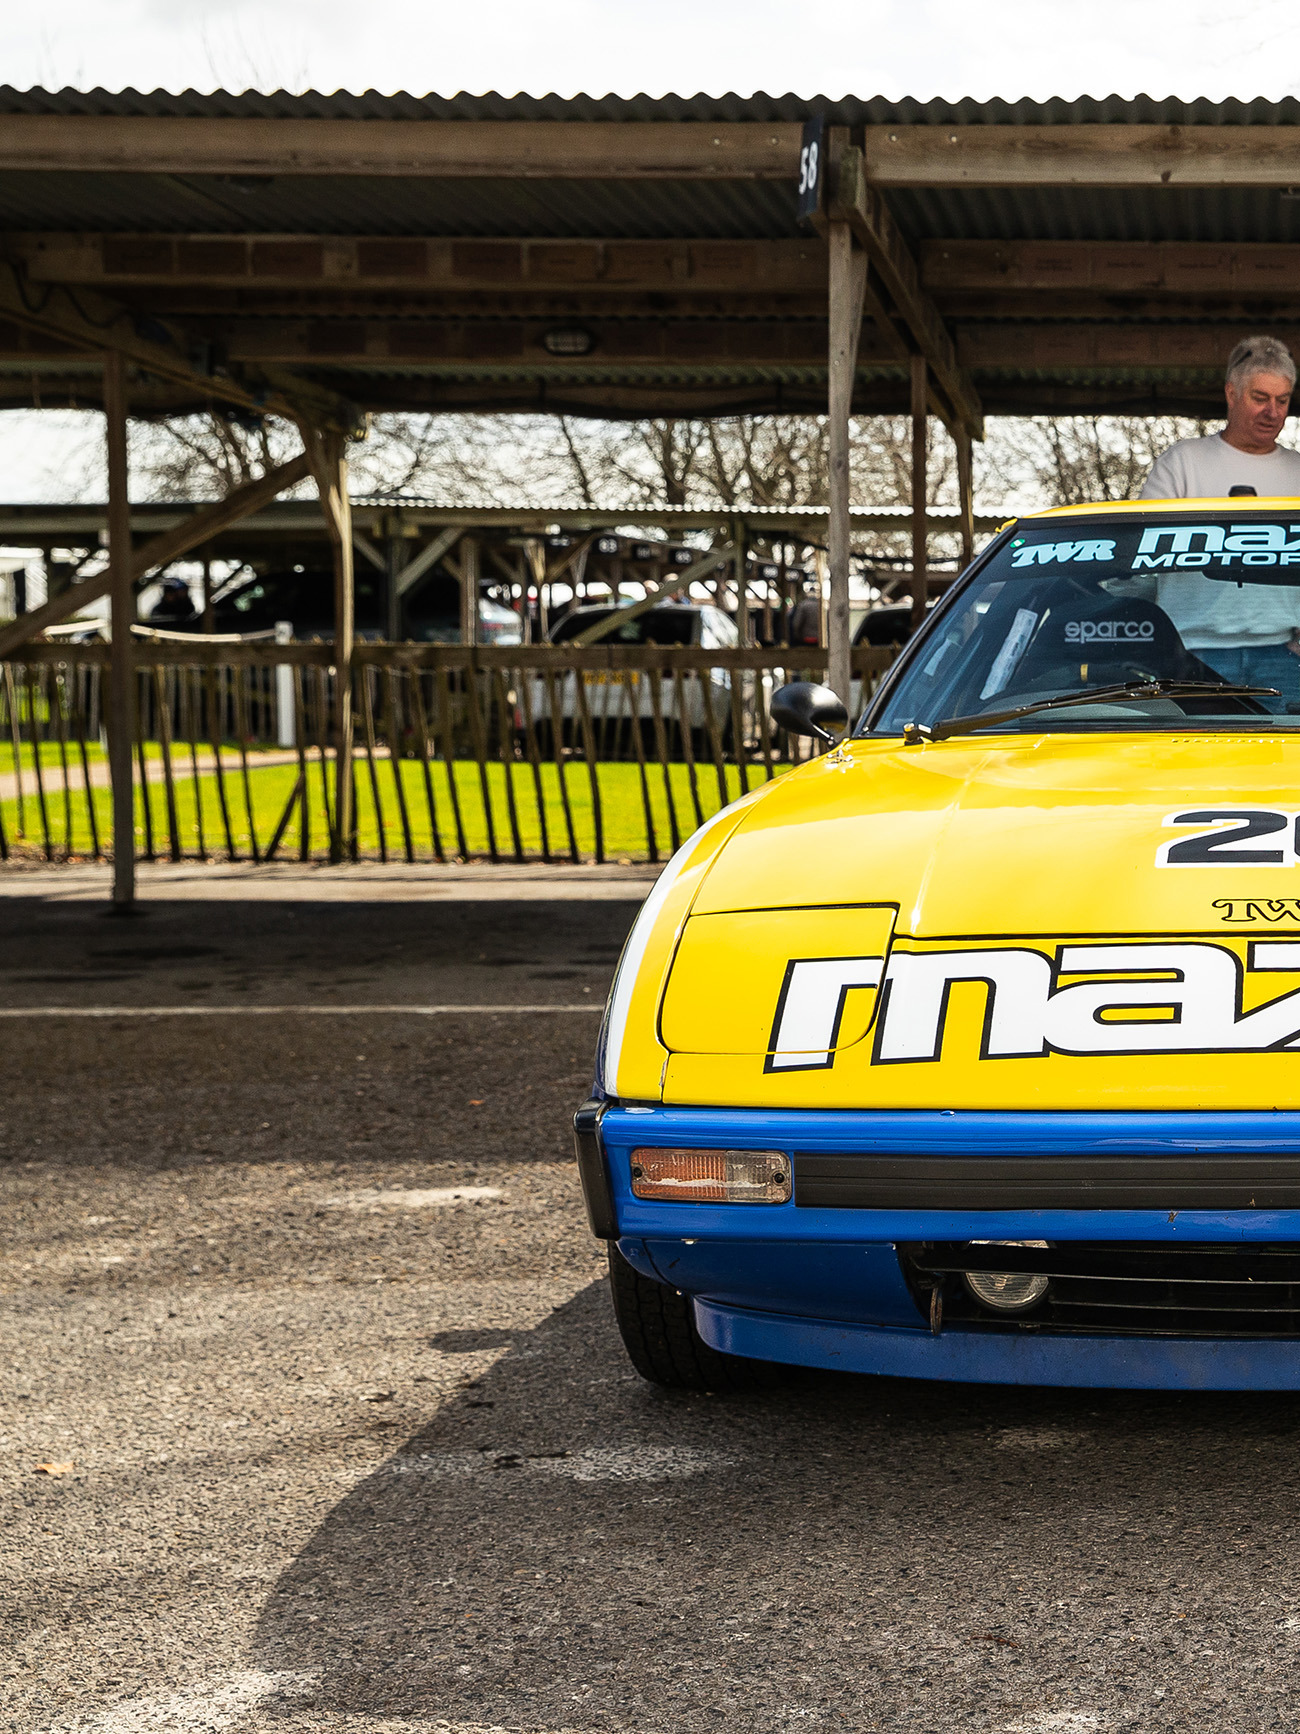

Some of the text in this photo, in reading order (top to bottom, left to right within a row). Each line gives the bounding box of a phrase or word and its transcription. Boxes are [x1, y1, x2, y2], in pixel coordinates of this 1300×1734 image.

[799, 141, 819, 195] 58
[1011, 540, 1117, 568] TWR
[1064, 621, 1155, 644] sparco
